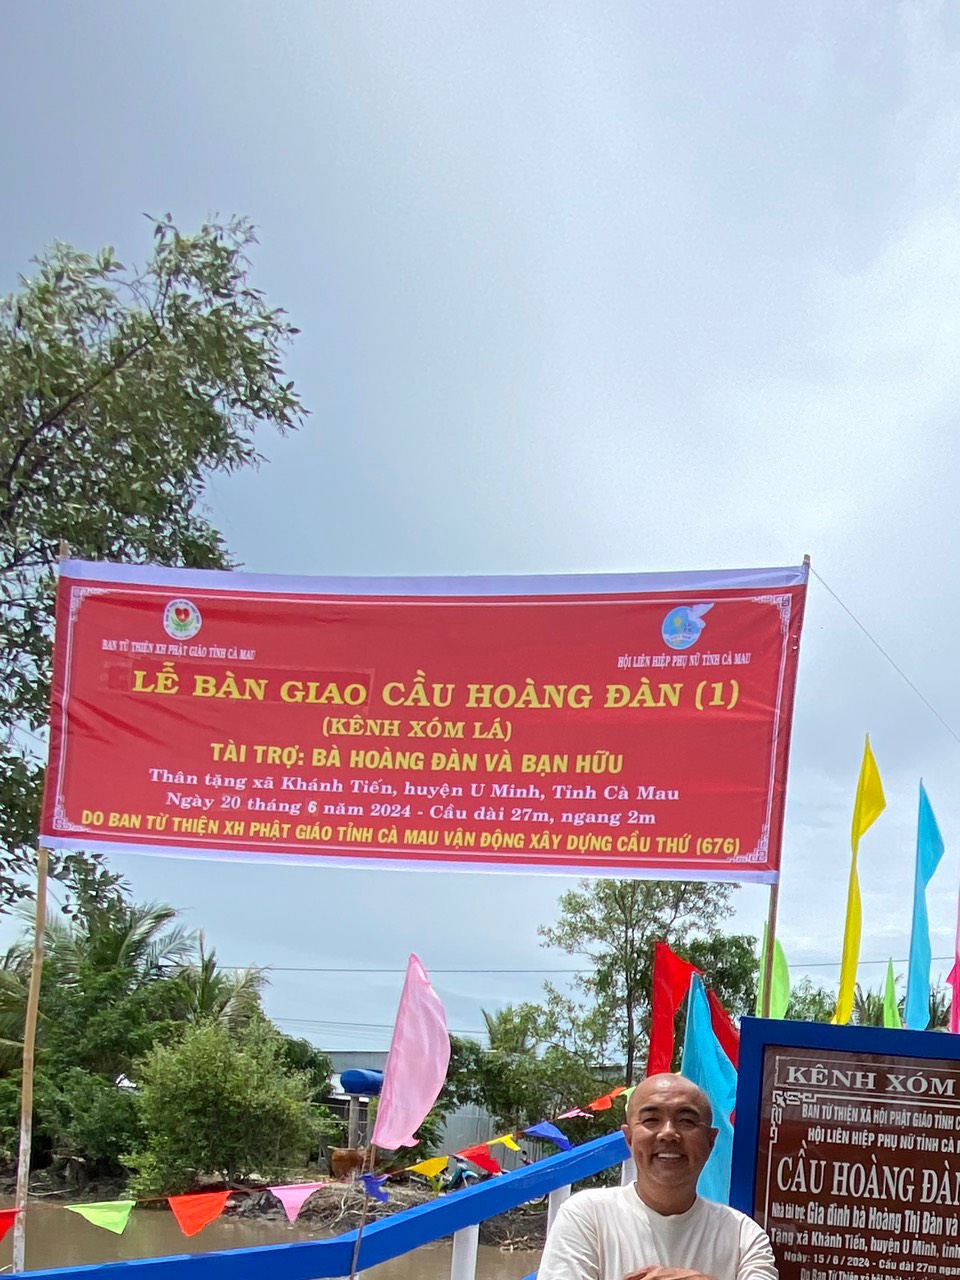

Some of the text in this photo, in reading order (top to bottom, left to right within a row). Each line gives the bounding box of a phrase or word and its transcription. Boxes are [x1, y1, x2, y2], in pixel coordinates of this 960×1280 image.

[102, 639, 117, 650] BAN
[119, 639, 130, 652] TỪ
[131, 640, 154, 654] THIỆN
[155, 644, 167, 654] XH
[168, 642, 188, 657] PHẬT
[189, 644, 206, 658] GIÁO
[228, 647, 238, 659] CÀ
[240, 650, 256, 660] MAU
[618, 653, 632, 670] HỘI
[632, 653, 651, 668] LIÊN
[652, 652, 670, 669] HIỆP
[672, 655, 688, 669] PHỤ
[689, 652, 700, 665] NỮ
[722, 651, 732, 664] CÀ
[734, 652, 751, 664] MAU
[132, 662, 739, 710] LỄ BÀN GIAO CẦU HOÀNG ĐÀN (1)
[322, 714, 512, 742] (KÊNH XÓM LÁ)
[210, 739, 624, 776] TÀI TRỢ: BÀ HOÀNG ĐÀN VÀ BẠN HỮU
[149, 768, 680, 801] Thân tặng xã Khánh Tiến, huyện U Minh, Tỉnh Cà Mau
[166, 792, 215, 810] Ngày
[220, 796, 240, 809] 20
[247, 798, 302, 815] tháng
[308, 800, 318, 814] 6
[323, 802, 364, 816] năm
[370, 803, 411, 818] 2024
[430, 804, 467, 820] Cầu
[474, 806, 504, 821] dài
[510, 808, 554, 824] 27m,
[561, 812, 622, 826] ngang
[627, 810, 656, 824] 2m
[82, 810, 740, 855] DO BAN TỪ THIỆN XH PHẬT GIÁO TỈNH CÀ MAU VẬN ĐỘNG XÂY DỰNG CẦU THỨ (676)
[786, 1064, 876, 1089] KÊNH
[885, 1072, 956, 1096] XÓM
[802, 1104, 820, 1118] BAN
[822, 1102, 834, 1120] TỪ
[834, 1105, 858, 1124] THIỆN
[860, 1106, 872, 1122] XÃ
[873, 1107, 888, 1127] HỘI
[890, 1109, 911, 1129] PHẬT
[912, 1110, 932, 1128] GIÁO
[808, 1125, 824, 1144] HỘI
[827, 1127, 849, 1144] LIÊN
[851, 1130, 875, 1148] HIỆP
[877, 1134, 898, 1151] PHỤ
[900, 1134, 916, 1150] NỮ
[941, 1136, 954, 1153] CÀ
[776, 1140, 827, 1194] CẦU
[830, 1154, 916, 1202] HOÀNG
[807, 1201, 824, 1225] Gia
[826, 1202, 850, 1228] đình
[852, 1205, 866, 1228] bà
[868, 1206, 902, 1234] Hoàng
[904, 1210, 920, 1238] Thị
[922, 1211, 943, 1235] Đàn
[946, 1213, 958, 1236] và
[770, 1227, 794, 1246] Tặng
[796, 1230, 808, 1246] xã
[811, 1231, 842, 1248] Khánh
[845, 1233, 868, 1252] Tiến,
[870, 1236, 900, 1256] huyện
[902, 1239, 910, 1254] U
[912, 1240, 939, 1258] Minh,
[847, 1256, 870, 1268] 2024
[916, 1262, 936, 1273] 27m
